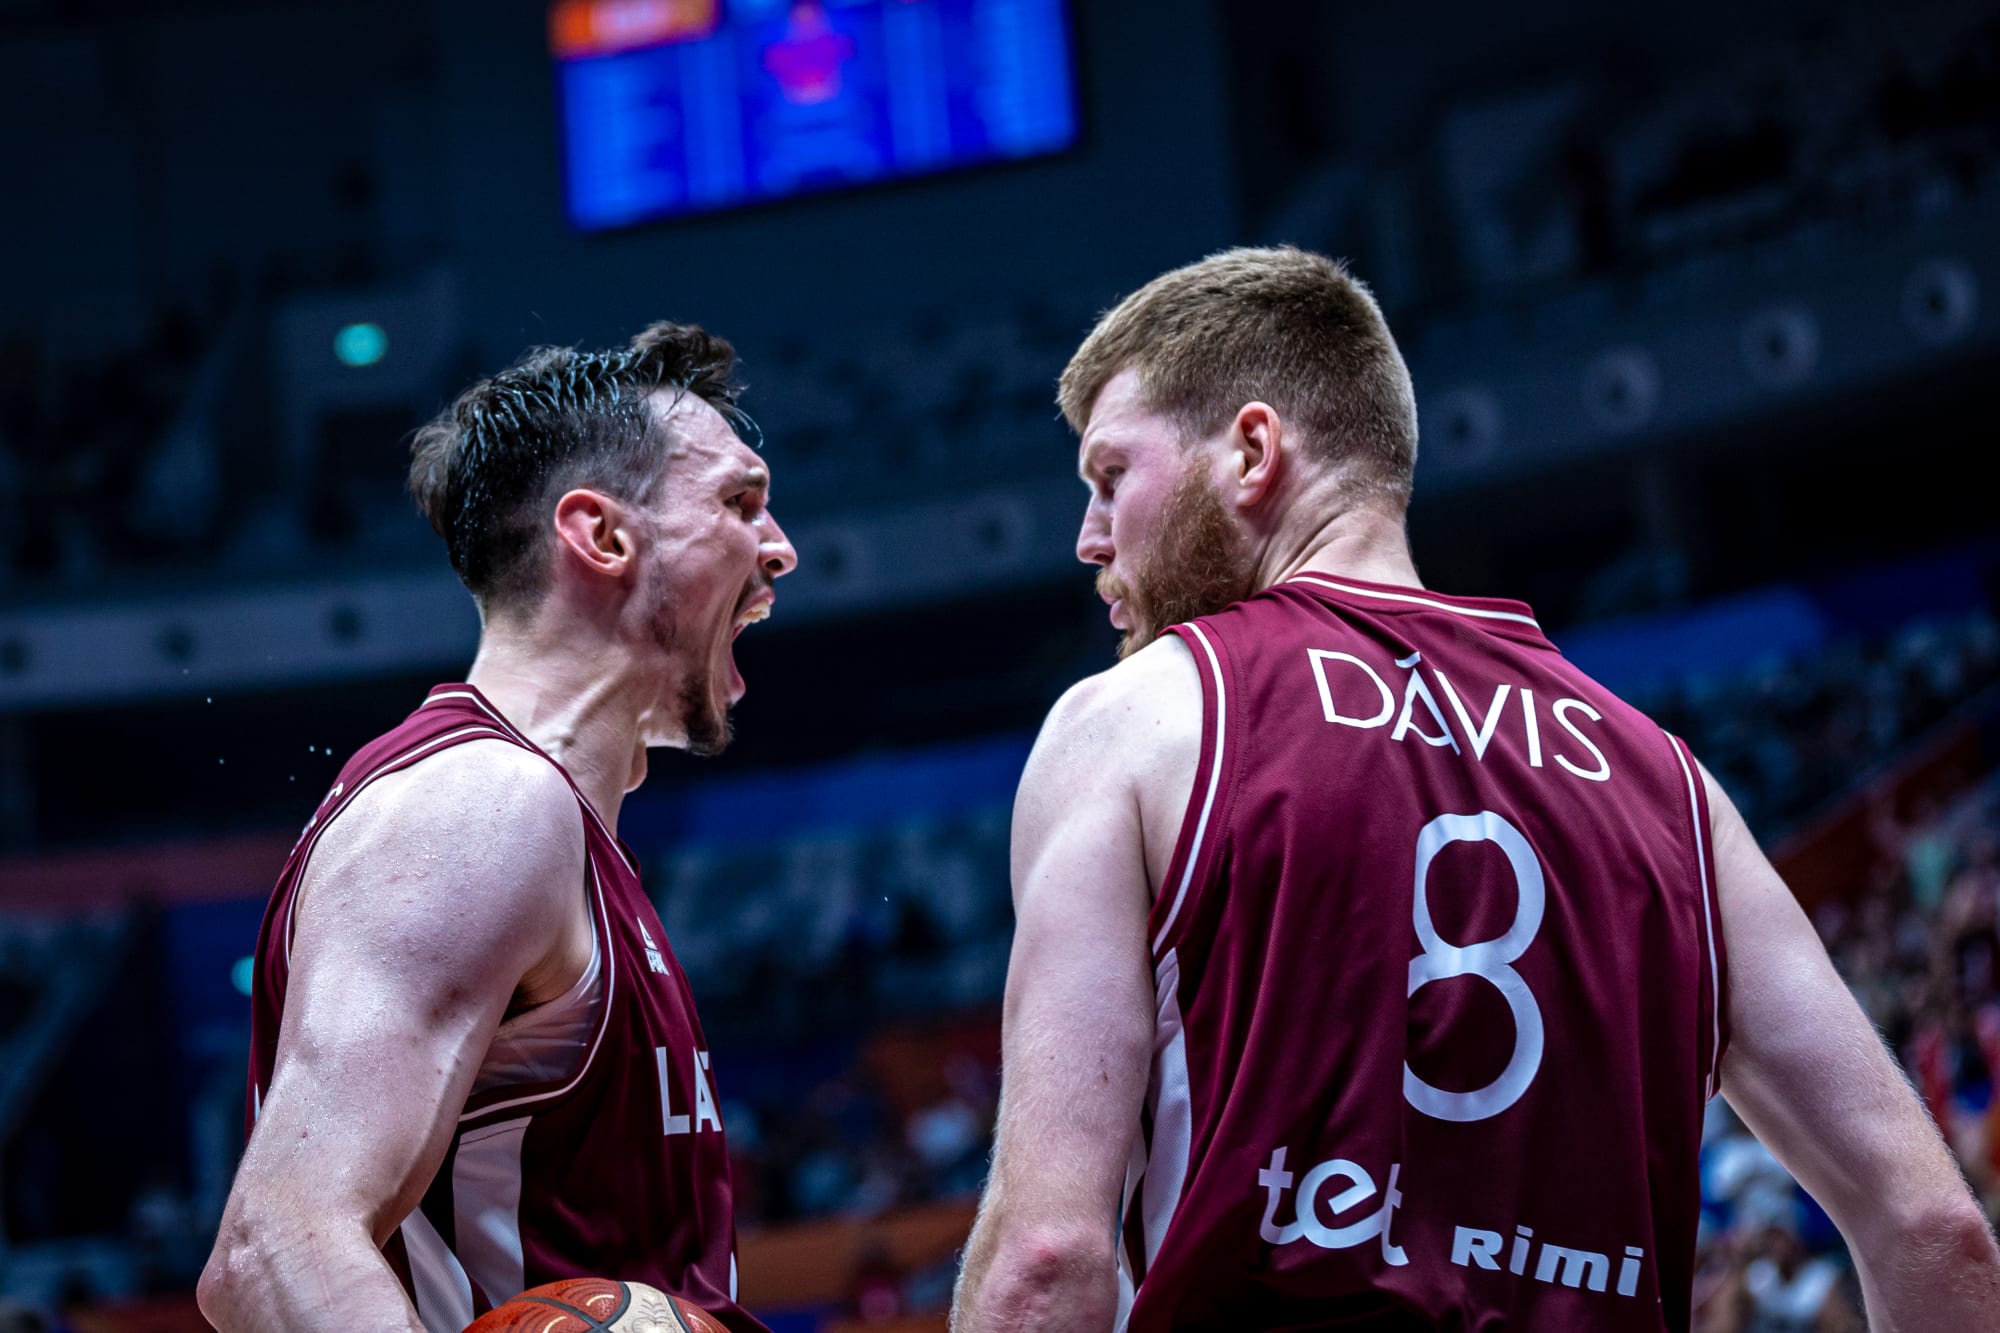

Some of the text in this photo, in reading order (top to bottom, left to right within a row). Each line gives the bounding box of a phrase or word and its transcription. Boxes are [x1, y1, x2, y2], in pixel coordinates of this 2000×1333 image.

[1402, 810, 1546, 1122] 8
[655, 1045, 723, 1136] LA
[1258, 1145, 1410, 1266] tet
[1450, 1224, 1644, 1298] Rimi
